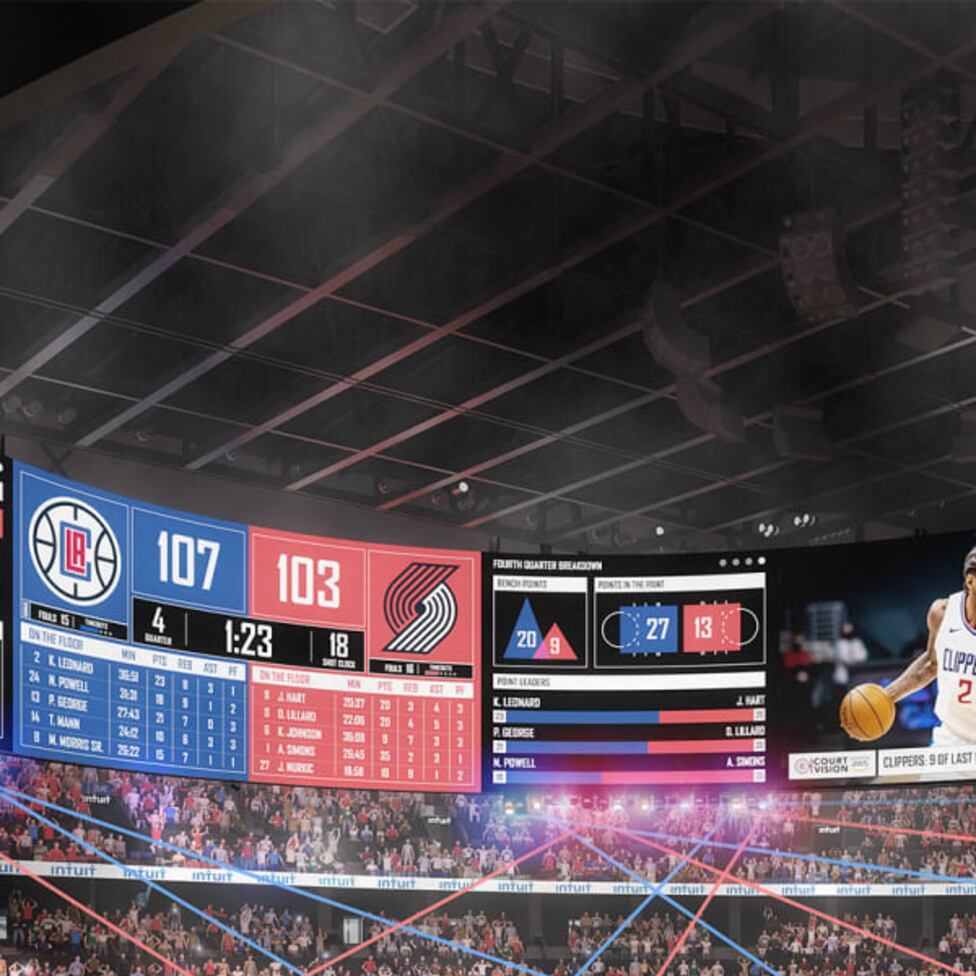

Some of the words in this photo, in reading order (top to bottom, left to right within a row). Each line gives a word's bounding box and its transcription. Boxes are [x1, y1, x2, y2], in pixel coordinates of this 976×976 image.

[158, 530, 220, 590] 107
[493, 559, 522, 569] FOURTH
[524, 560, 557, 570] QUARTER
[558, 561, 602, 570] BREAKDOWN
[278, 554, 340, 608] 103
[152, 606, 165, 633] 4
[646, 618, 669, 639] 27
[694, 617, 712, 638] 13
[226, 620, 272, 658] 1:23
[330, 632, 348, 657] 18
[517, 631, 536, 648] 20
[550, 637, 560, 654] 9
[958, 679, 972, 703] 2
[503, 698, 540, 708] LEONARD
[504, 758, 536, 768] POWELL
[814, 756, 848, 766] COURT
[883, 755, 927, 768] CLIPPERS:
[929, 755, 935, 766] 9
[937, 754, 948, 765] OF
[951, 753, 972, 765] LAST
[814, 765, 848, 774] VISION
[83, 794, 109, 804] intuit
[51, 864, 96, 876] intuit
[192, 870, 233, 882] intuit
[319, 875, 357, 886] intuit
[378, 877, 416, 889] intuit
[499, 881, 533, 892] intuit
[556, 881, 592, 892] intuit
[613, 883, 648, 894] intuit
[671, 883, 705, 894] intuit
[782, 885, 816, 895] intuit
[837, 885, 871, 895] intuit
[892, 885, 927, 895] intuit
